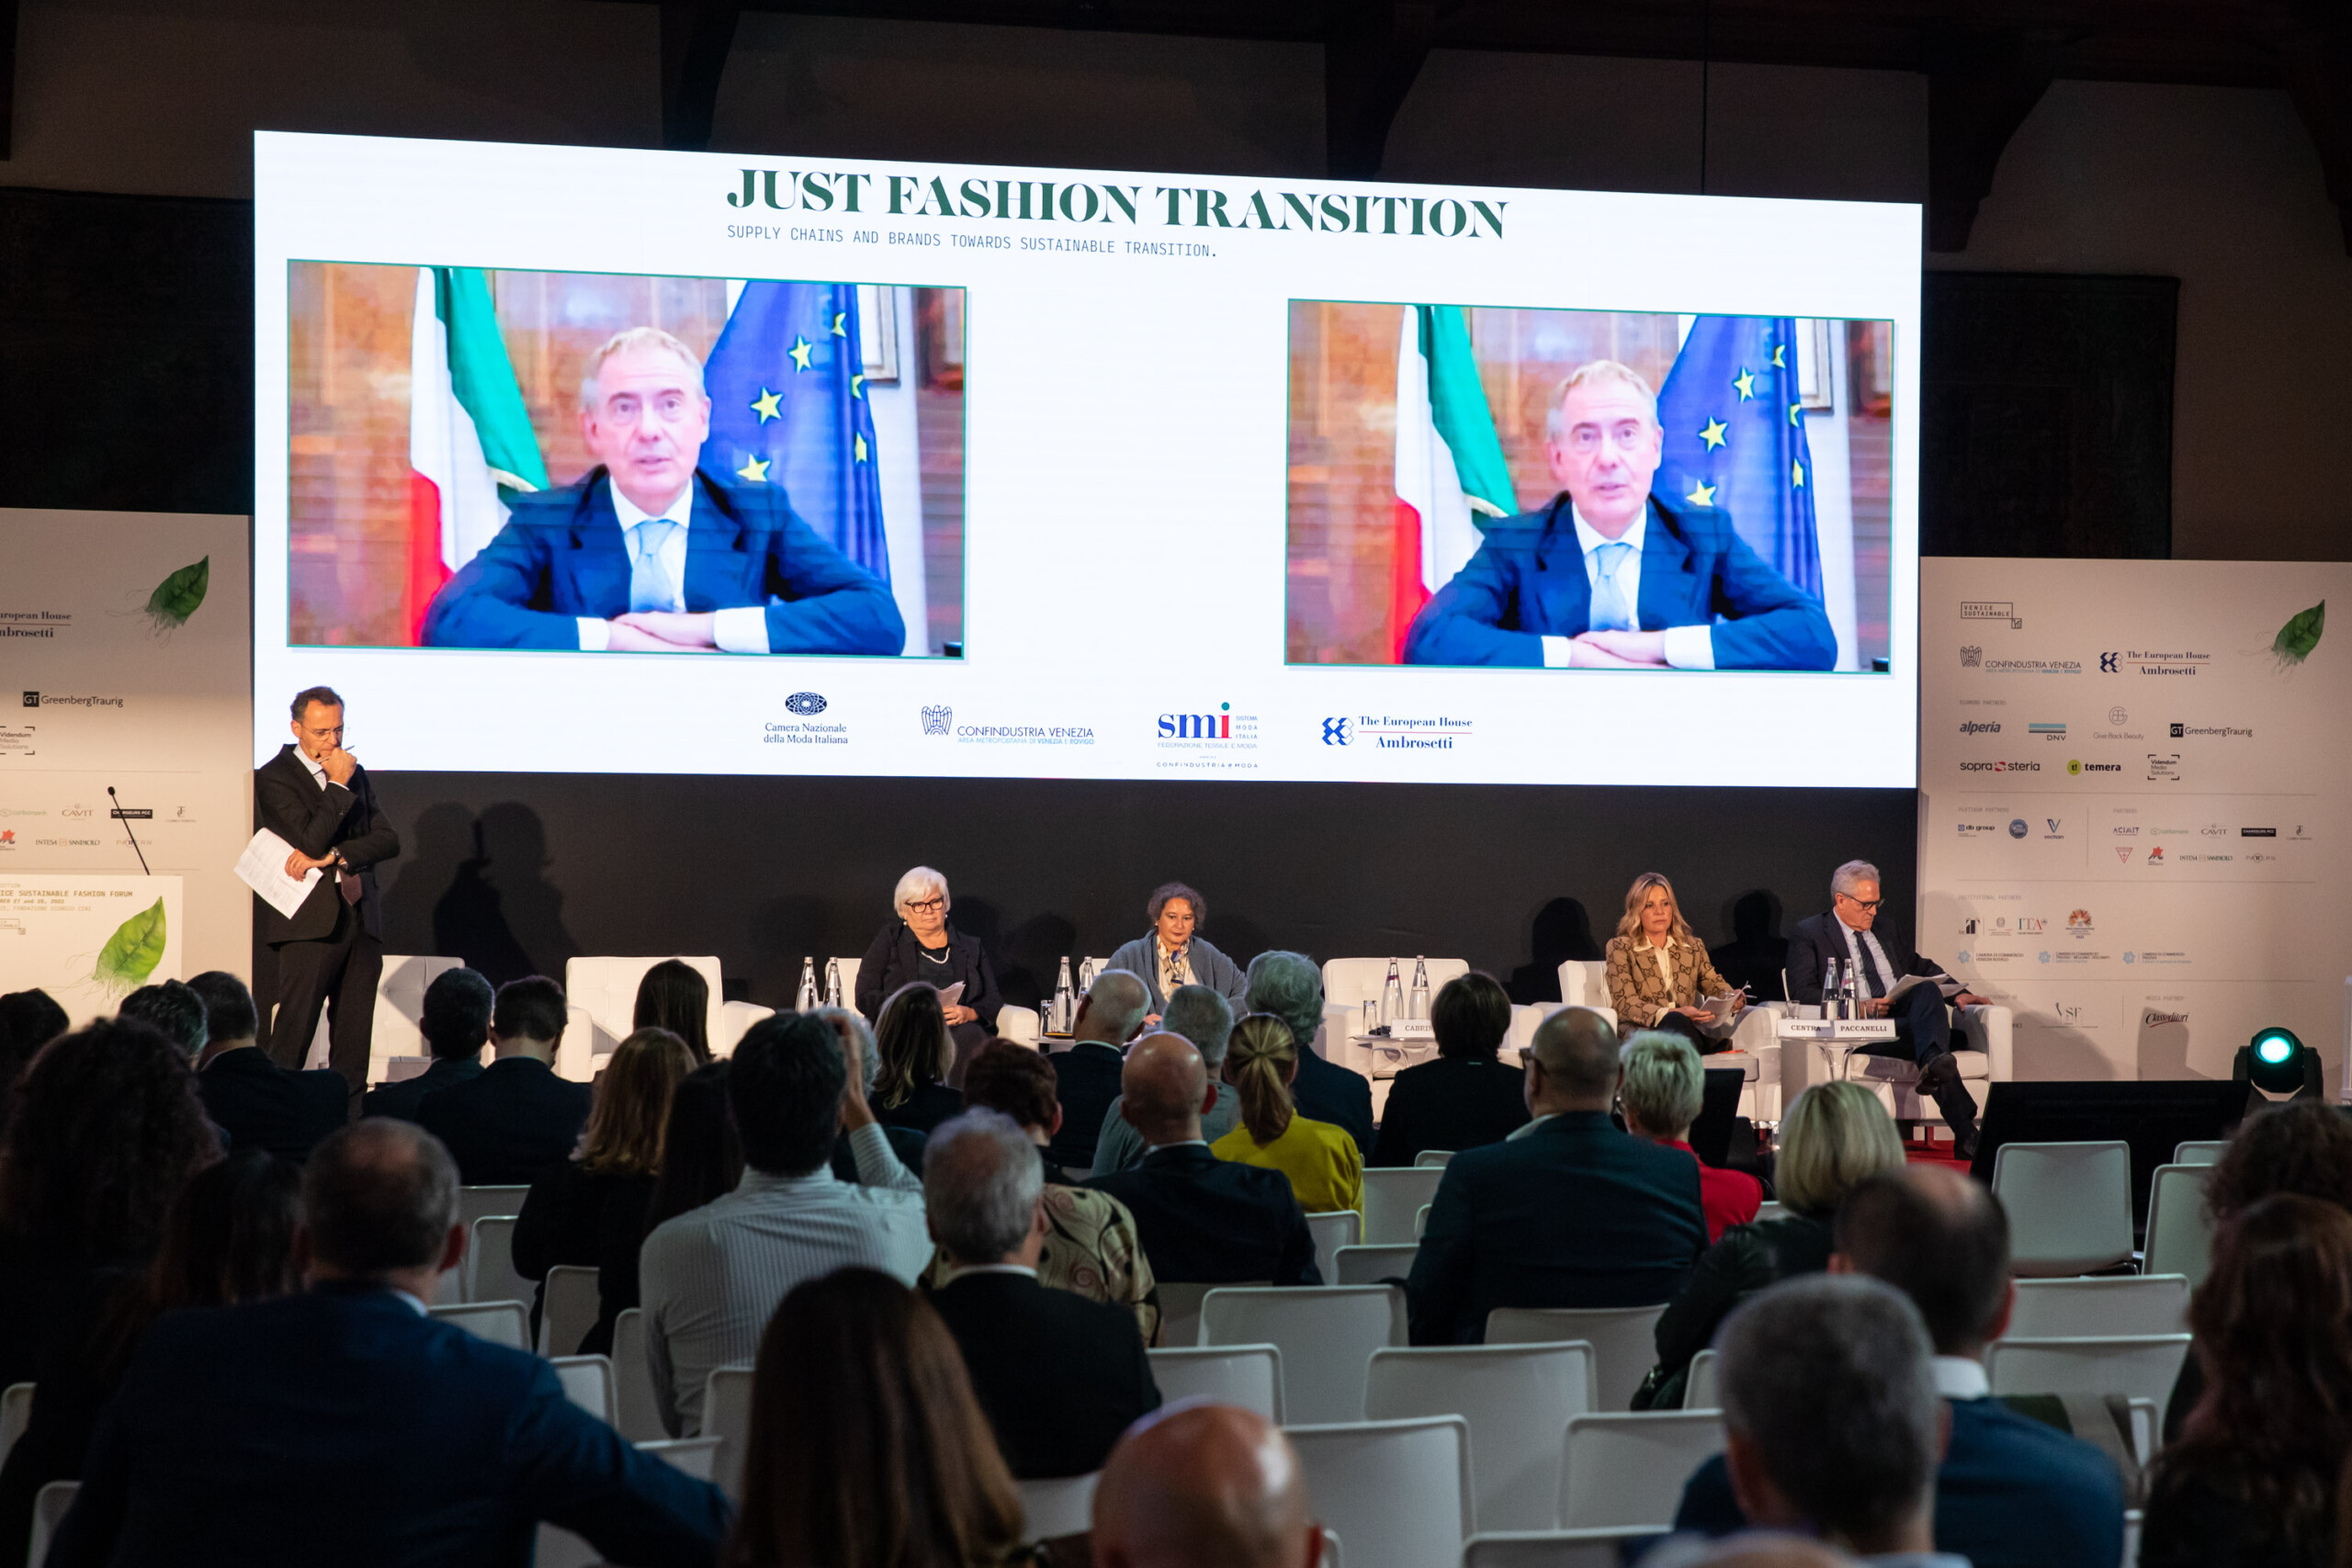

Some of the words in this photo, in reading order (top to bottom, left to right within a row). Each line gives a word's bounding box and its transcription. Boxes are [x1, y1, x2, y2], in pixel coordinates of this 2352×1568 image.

[727, 169, 871, 212] JUST
[885, 175, 1144, 225] FASHION
[1156, 186, 1510, 240] TRANSITION
[727, 225, 781, 240] SUPPLY
[790, 227, 843, 243] CHAINS
[853, 231, 879, 243] AND
[888, 231, 941, 246] BRANDS
[950, 234, 1012, 249] TOWARDS
[1020, 237, 1115, 254] SUSTAINABLE
[1125, 241, 1217, 257] TRANSITION.
[0, 613, 38, 622] uropean
[41, 611, 73, 620] House
[2127, 650, 2143, 659] The
[2144, 650, 2184, 660] European
[2186, 651, 2211, 660] House
[1984, 660, 2047, 669] CONFINDUSTRIA
[2049, 660, 2082, 670] VENEZIA
[2139, 665, 2196, 675] Ambrosetti
[24, 694, 39, 705] GT
[40, 695, 123, 707] GreenbergTraurig
[1158, 702, 1232, 739] smi
[1359, 716, 1380, 726] The
[1383, 716, 1435, 728] European
[1439, 716, 1473, 727] House
[764, 722, 799, 732] Camera
[802, 723, 847, 733] Nazionale
[957, 726, 1046, 737] CONFINDUSTRIA
[1048, 727, 1094, 738] VENEZIA
[1959, 720, 2001, 736] alperia
[2171, 726, 2183, 735] GT
[2185, 727, 2253, 738] GreenbergTraurig
[763, 734, 785, 743] della
[786, 734, 813, 744] Moda
[815, 735, 848, 744] Italiana
[1375, 736, 1453, 750] Ambrosetti
[1960, 761, 1993, 772] sopra
[2007, 761, 2041, 771] steria
[2085, 763, 2121, 772] temera
[62, 808, 94, 817] CAVIT
